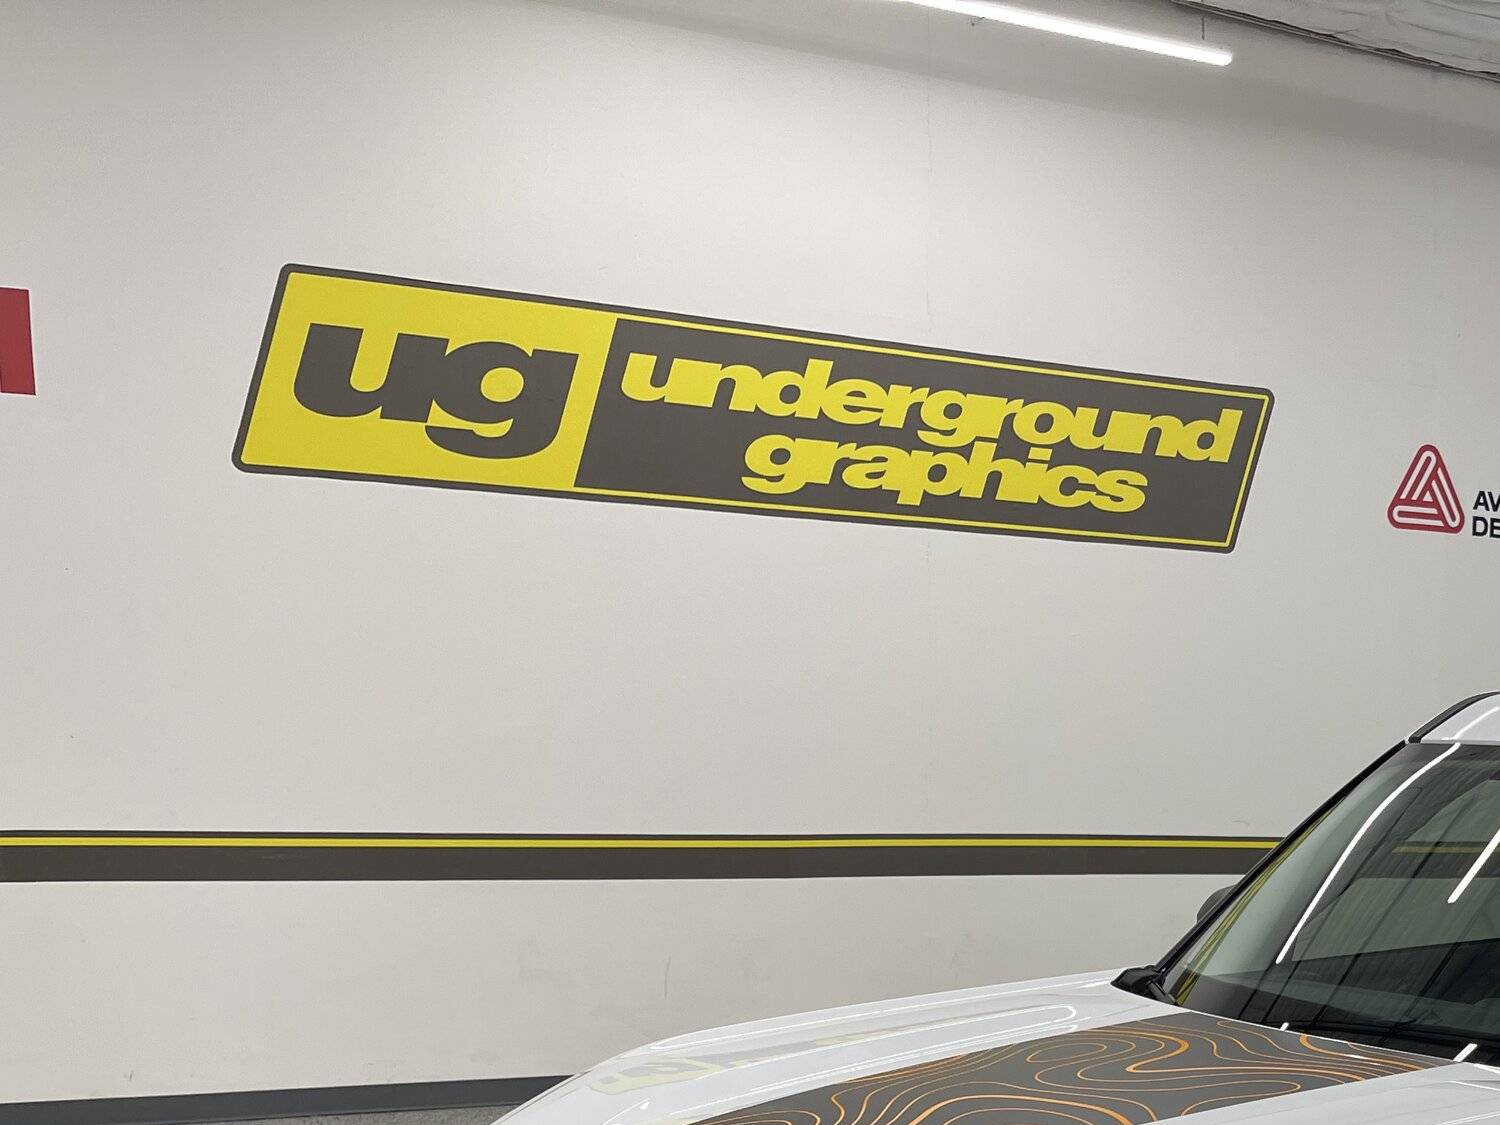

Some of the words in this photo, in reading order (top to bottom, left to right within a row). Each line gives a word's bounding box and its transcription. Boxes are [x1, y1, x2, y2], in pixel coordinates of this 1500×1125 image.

[294, 323, 579, 459] ug
[620, 353, 1243, 463] underground
[741, 434, 1148, 513] graphics
